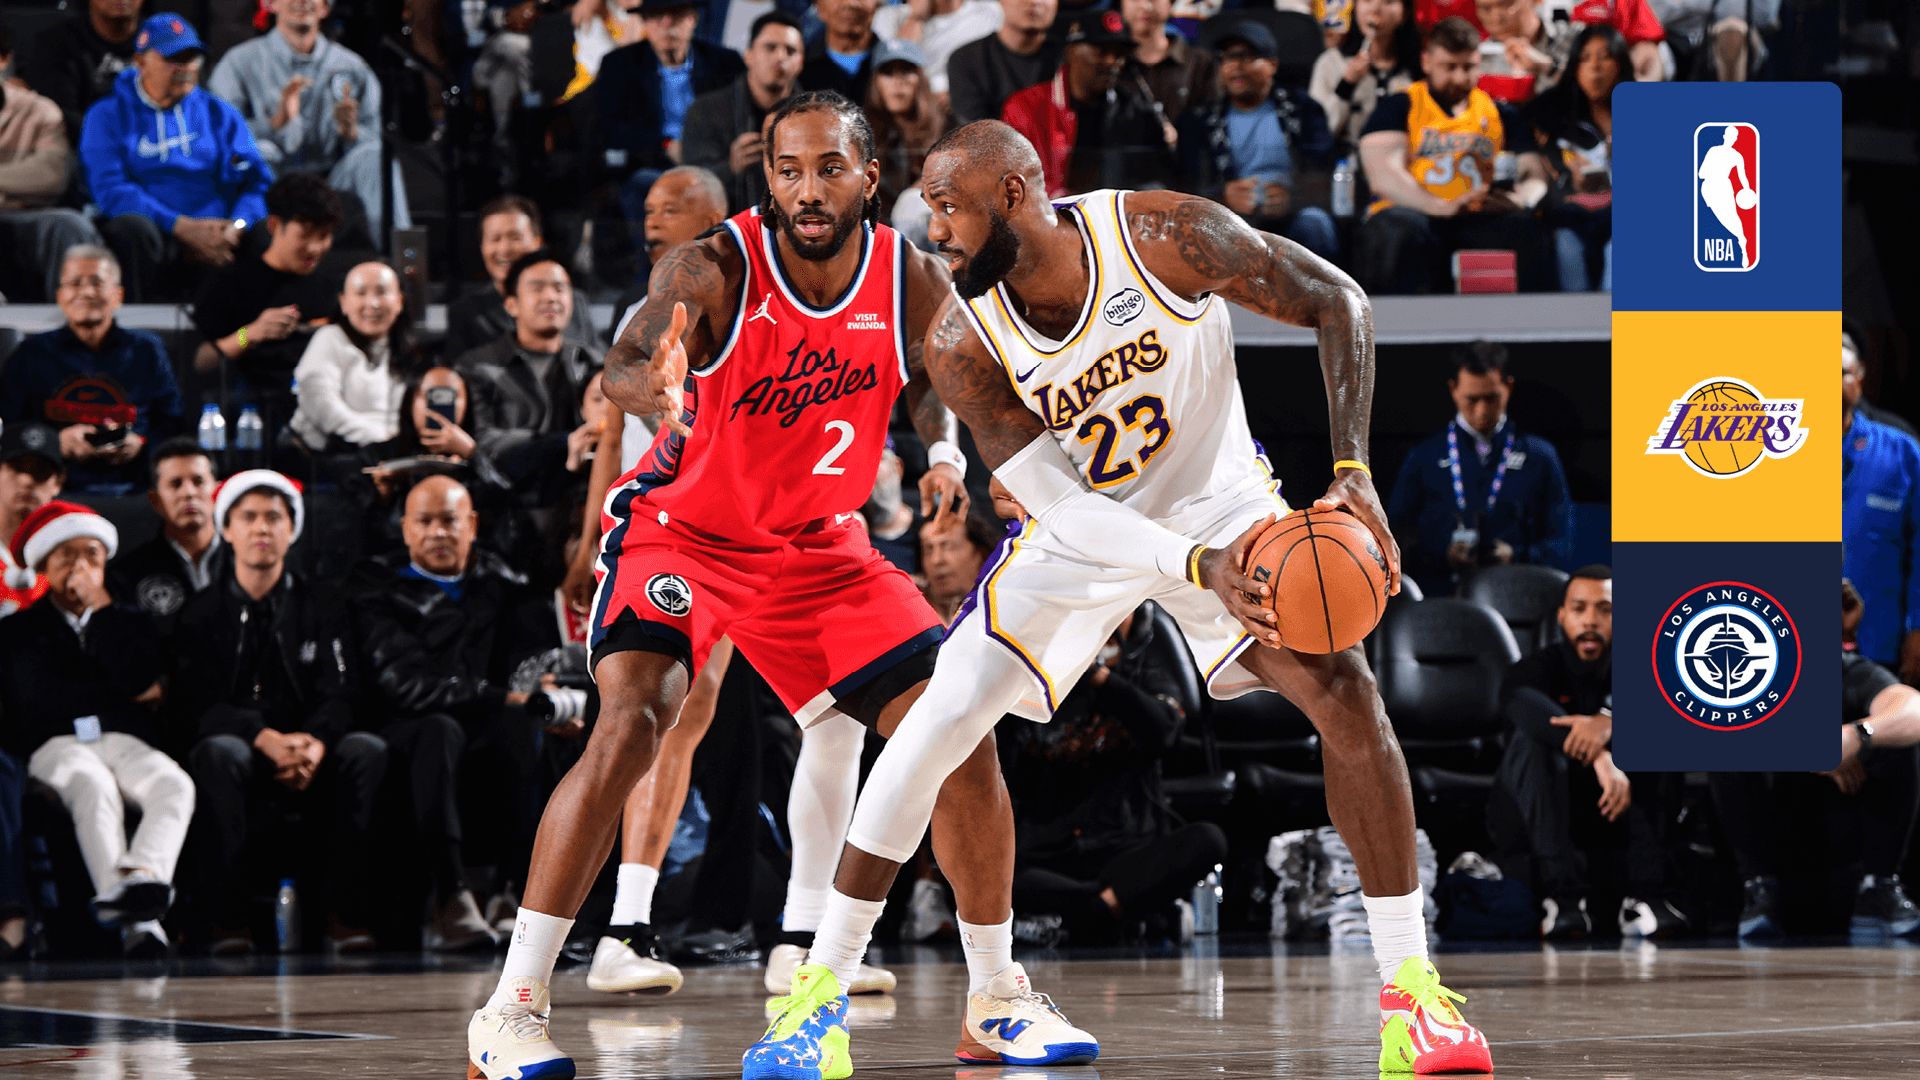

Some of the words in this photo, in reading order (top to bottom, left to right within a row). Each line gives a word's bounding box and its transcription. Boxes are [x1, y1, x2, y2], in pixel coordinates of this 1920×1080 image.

[847, 322, 887, 330] RWANDA
[854, 313, 878, 321] VISIT
[1106, 294, 1141, 319] bibigo
[777, 338, 842, 383] Los
[1030, 328, 1170, 432] LAKERS
[728, 358, 879, 428] Angeles
[812, 420, 855, 475] 2
[1076, 393, 1174, 489] 23
